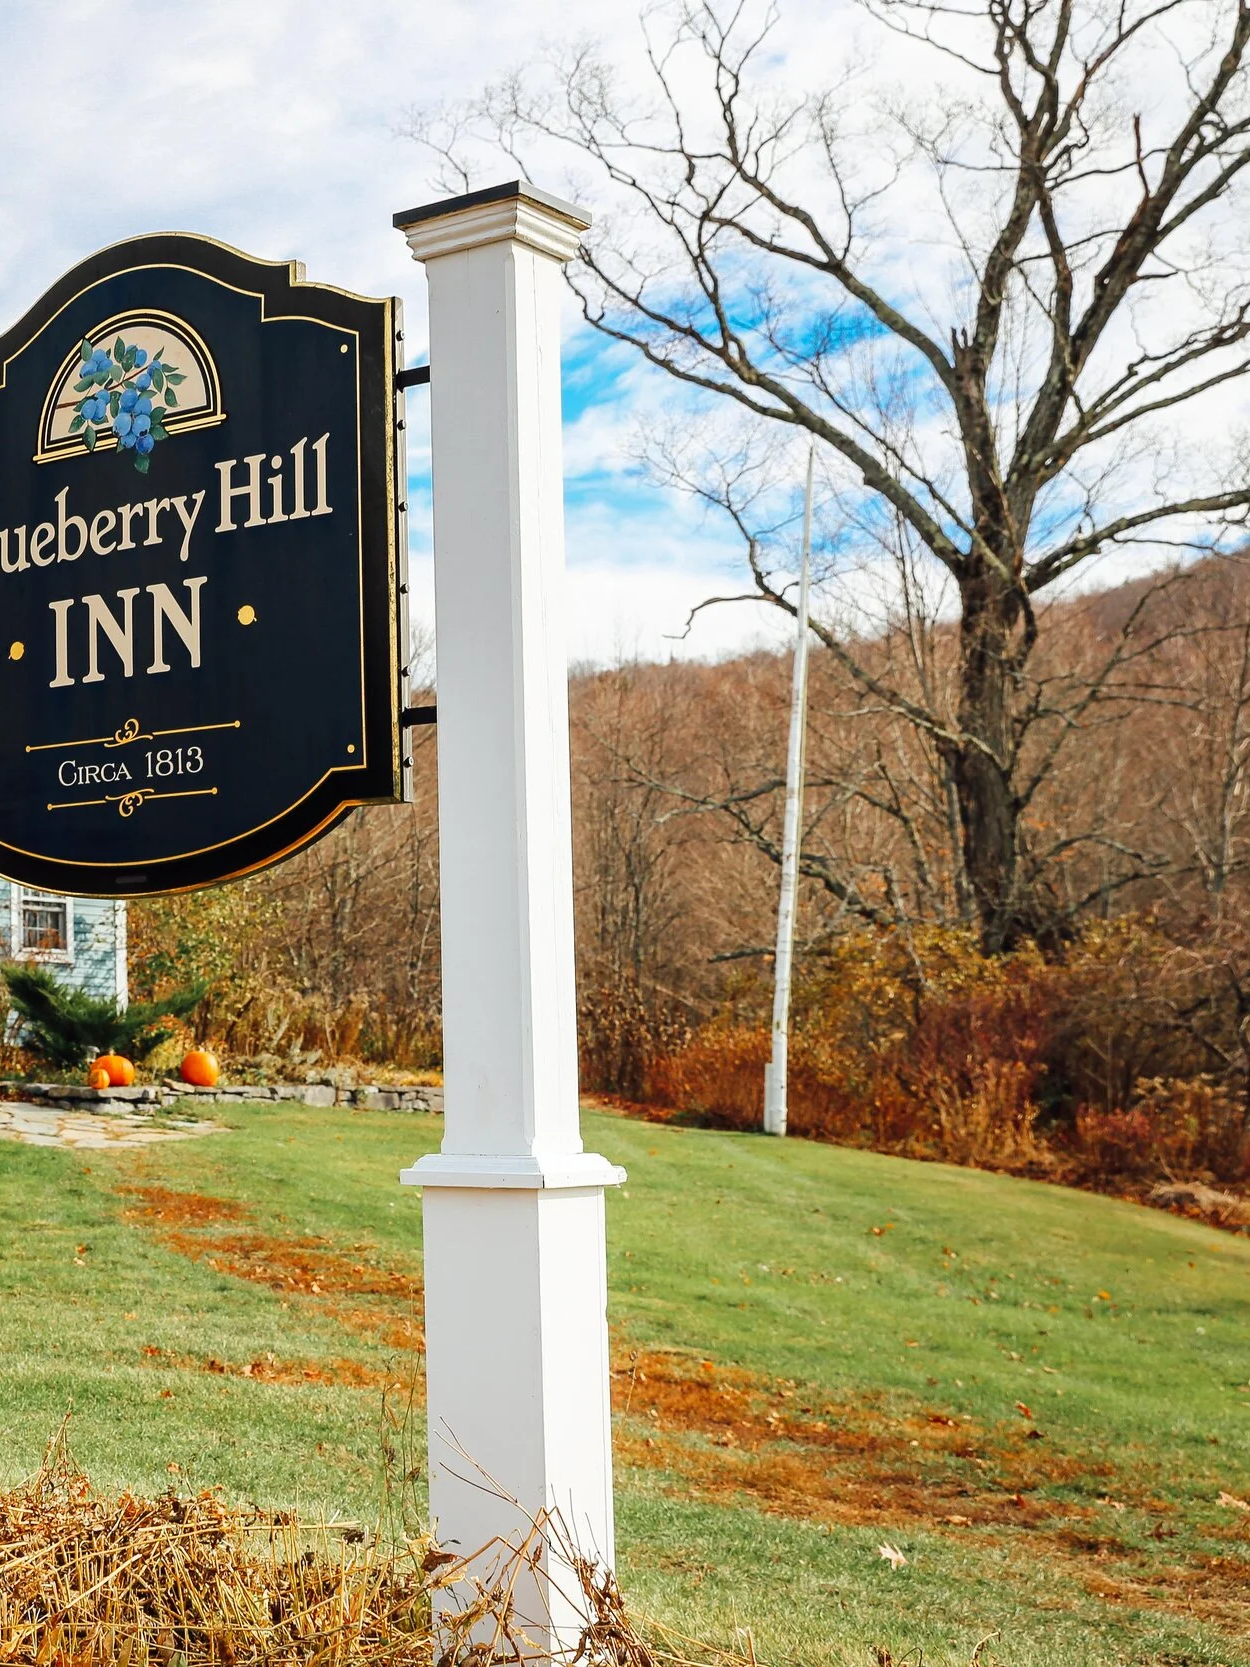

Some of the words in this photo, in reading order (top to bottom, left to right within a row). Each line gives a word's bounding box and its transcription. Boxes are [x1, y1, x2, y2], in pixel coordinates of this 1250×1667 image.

[214, 431, 334, 534] Hill
[48, 575, 208, 689] INN
[144, 746, 204, 778] 1813
